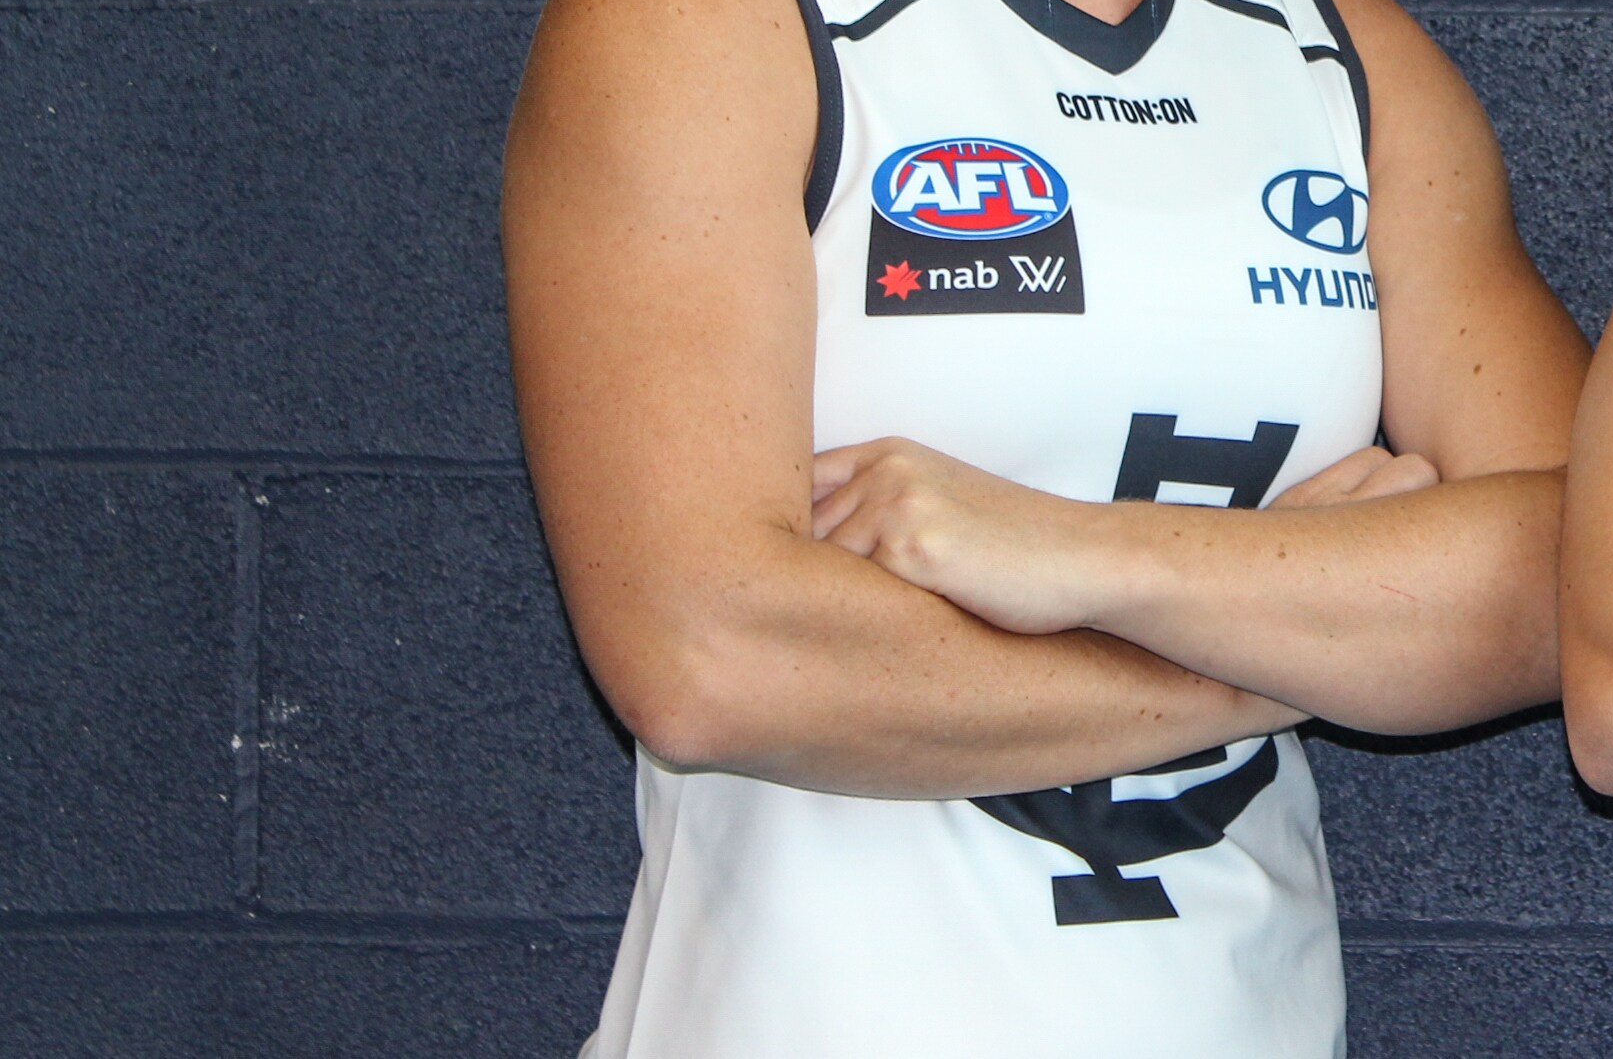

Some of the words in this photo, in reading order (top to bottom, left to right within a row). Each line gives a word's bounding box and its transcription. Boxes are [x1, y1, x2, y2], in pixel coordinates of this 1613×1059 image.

[1056, 92, 1197, 126] COTTON:ON
[890, 160, 1058, 214] AFL
[929, 260, 999, 289] nab
